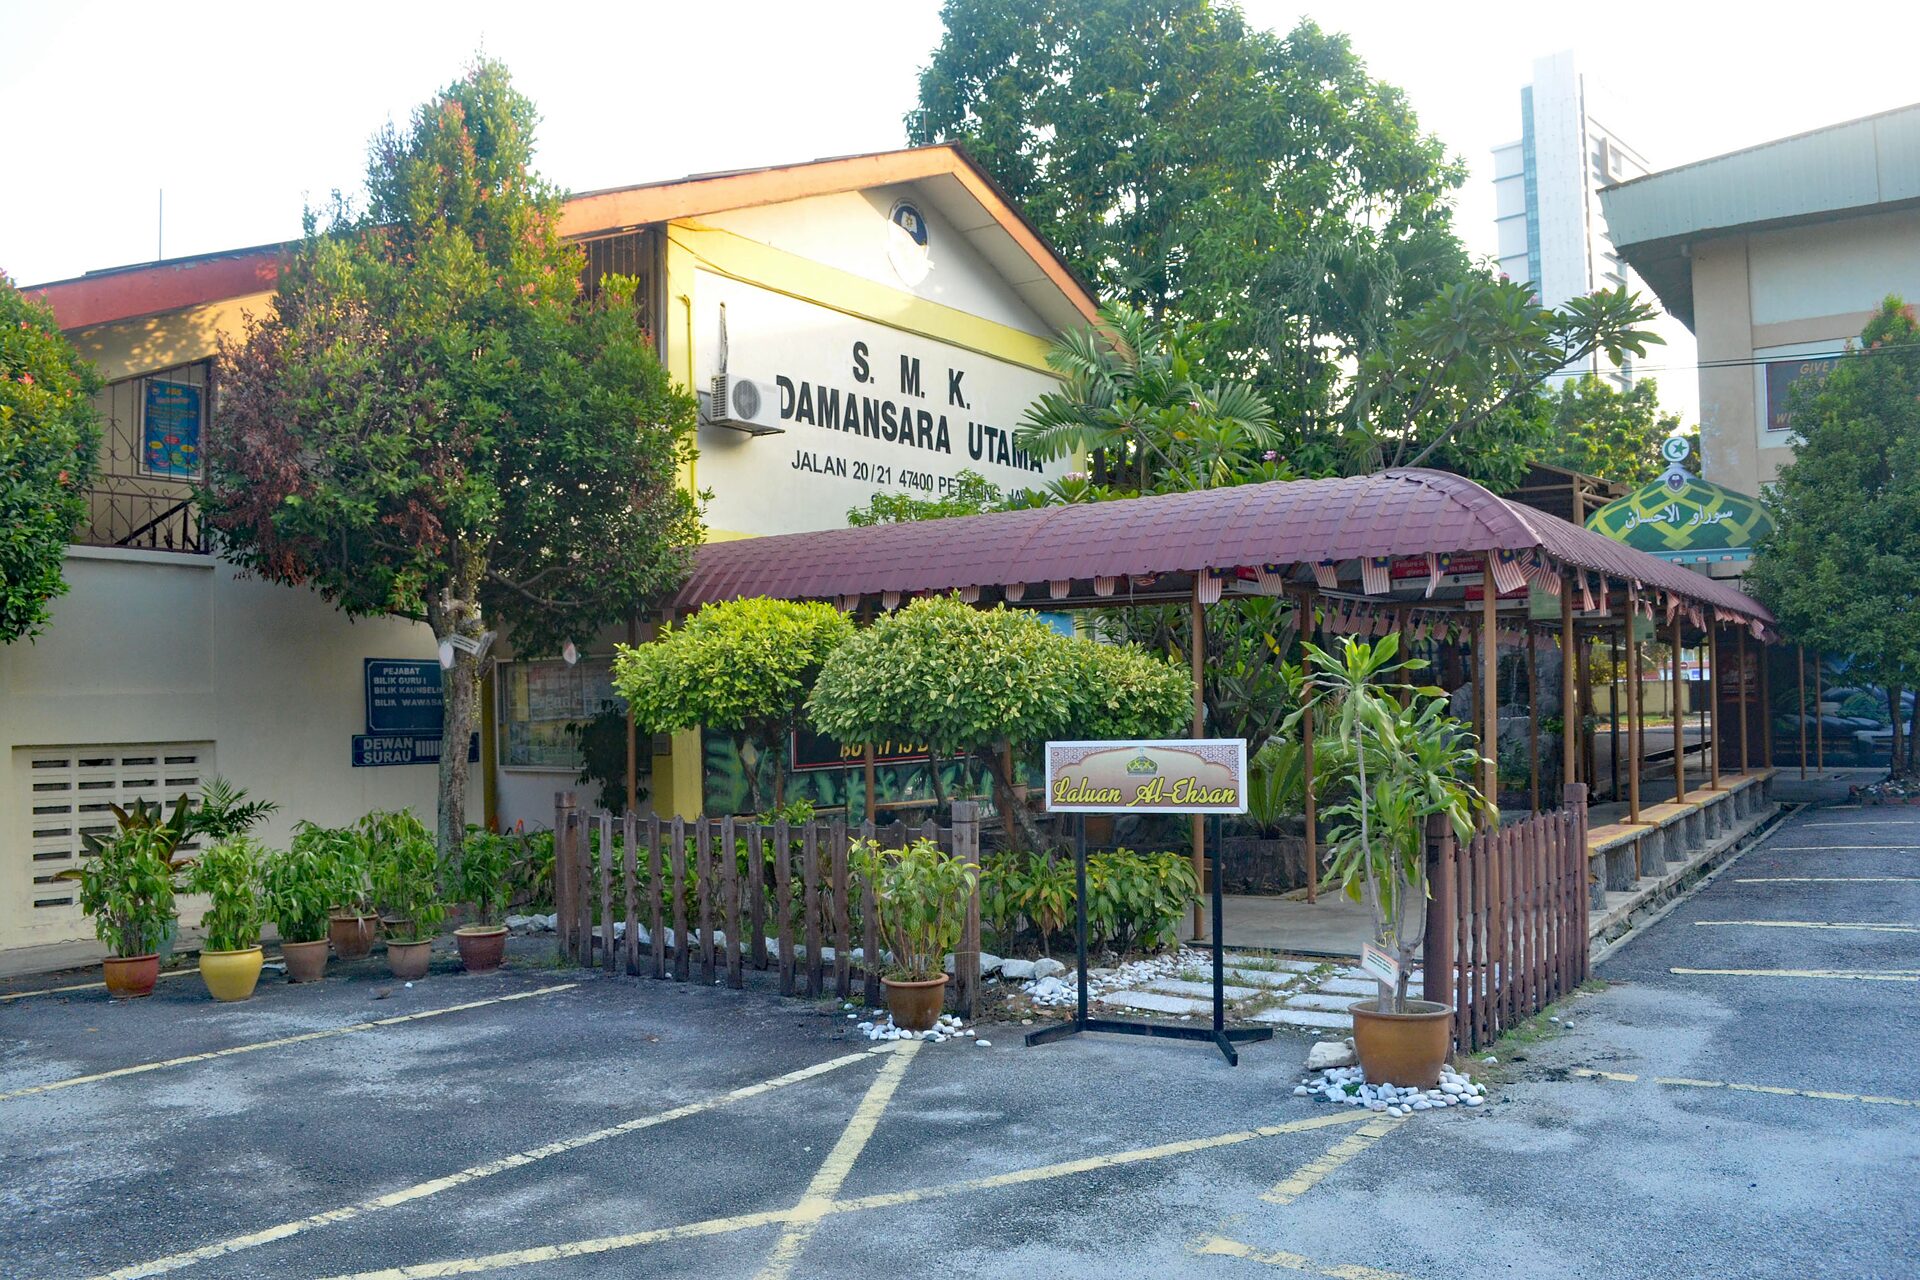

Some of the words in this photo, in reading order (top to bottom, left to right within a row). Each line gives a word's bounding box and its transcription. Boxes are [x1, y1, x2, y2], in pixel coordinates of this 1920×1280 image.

[1800, 360, 1830, 375] GIVE
[852, 341, 875, 384] S.
[900, 354, 926, 399] M.
[948, 367, 971, 410] K.
[776, 374, 952, 455] DAMANSARA
[791, 449, 847, 478] JALAN
[852, 460, 892, 485] 20/21
[898, 469, 934, 492] 47400
[383, 667, 421, 676] PEJABAT
[373, 676, 397, 685] BILIK
[398, 676, 422, 685] GURU
[374, 686, 397, 695] BILIK
[375, 698, 398, 707] BILIK
[363, 737, 414, 750] DEWAN
[363, 750, 412, 764] SURAU
[1053, 775, 1122, 804] Laluan
[1126, 776, 1237, 808] Al-Ehsan
